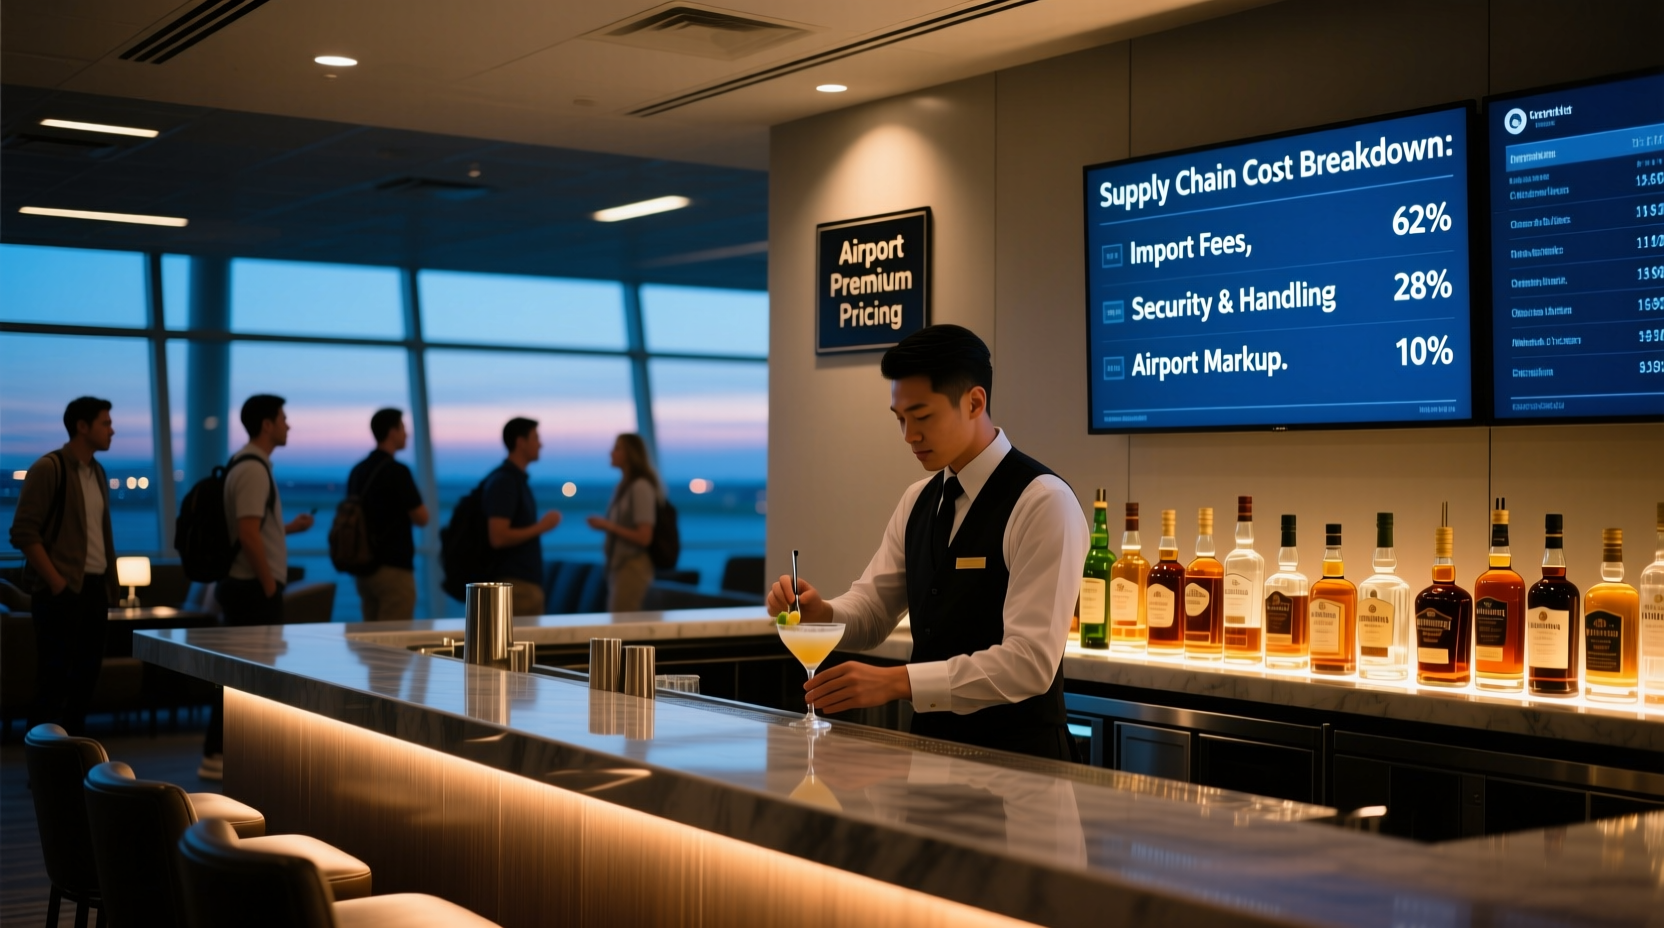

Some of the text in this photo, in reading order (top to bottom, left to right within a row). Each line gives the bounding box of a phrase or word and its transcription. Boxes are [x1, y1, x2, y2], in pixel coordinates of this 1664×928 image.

[1100, 135, 1453, 211] Supply Chain Cost Breakdown:
[1392, 201, 1452, 236] 62%
[839, 234, 904, 269] Airport
[1130, 232, 1253, 268] Import Fees,
[830, 267, 912, 297] Premium
[1394, 269, 1452, 302] 28%
[840, 300, 902, 330] Pricing
[1131, 281, 1336, 322] Security & Handling
[1131, 344, 1288, 381] Airport Markup.
[1396, 334, 1453, 366] 10%
